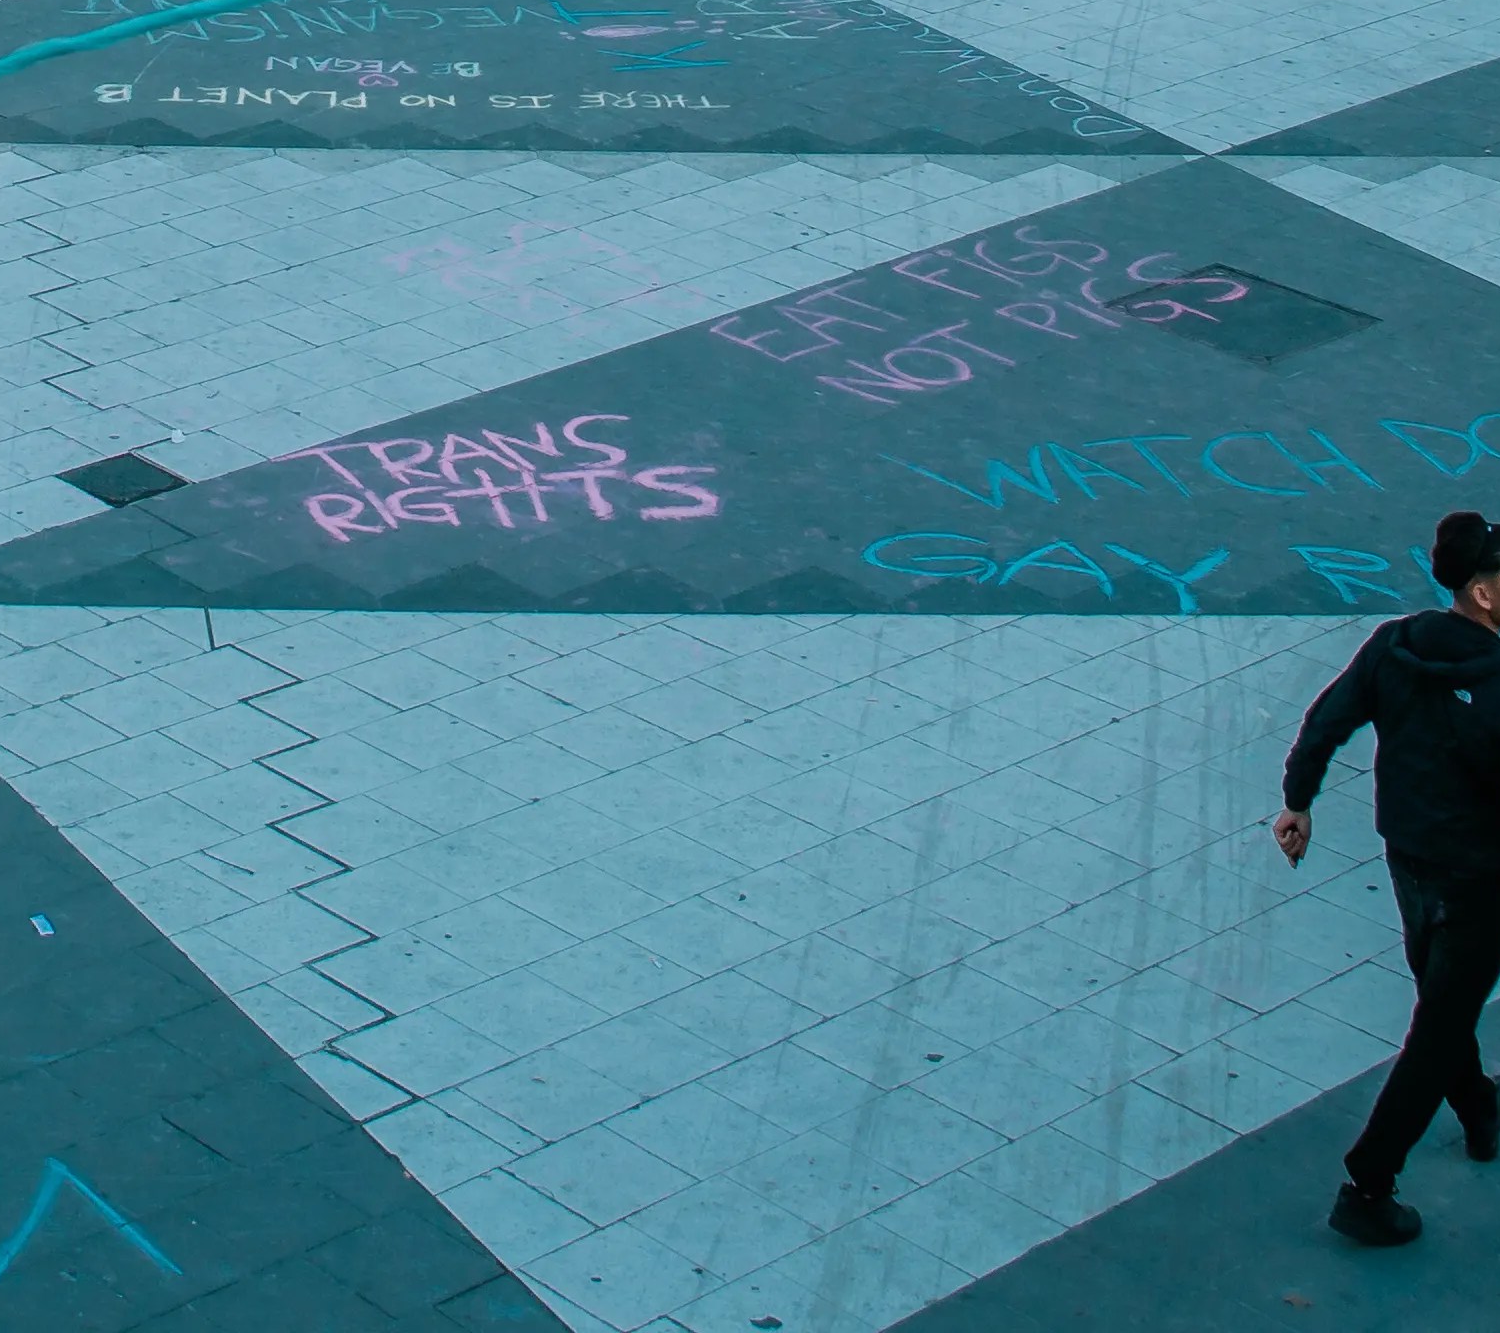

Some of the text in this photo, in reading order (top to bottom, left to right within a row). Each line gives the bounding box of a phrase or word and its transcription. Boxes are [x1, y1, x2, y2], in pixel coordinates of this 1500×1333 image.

[92, 82, 731, 112] THERE IS NO PLANET B
[264, 54, 482, 78] BE VEGAN
[708, 223, 1109, 364] EAT FIGS
[813, 251, 1251, 406] NOT PIGS
[269, 412, 631, 491] TRANS
[876, 427, 1386, 511] WATCH
[302, 464, 721, 542] RIGHTS
[860, 532, 1232, 616] GAY
